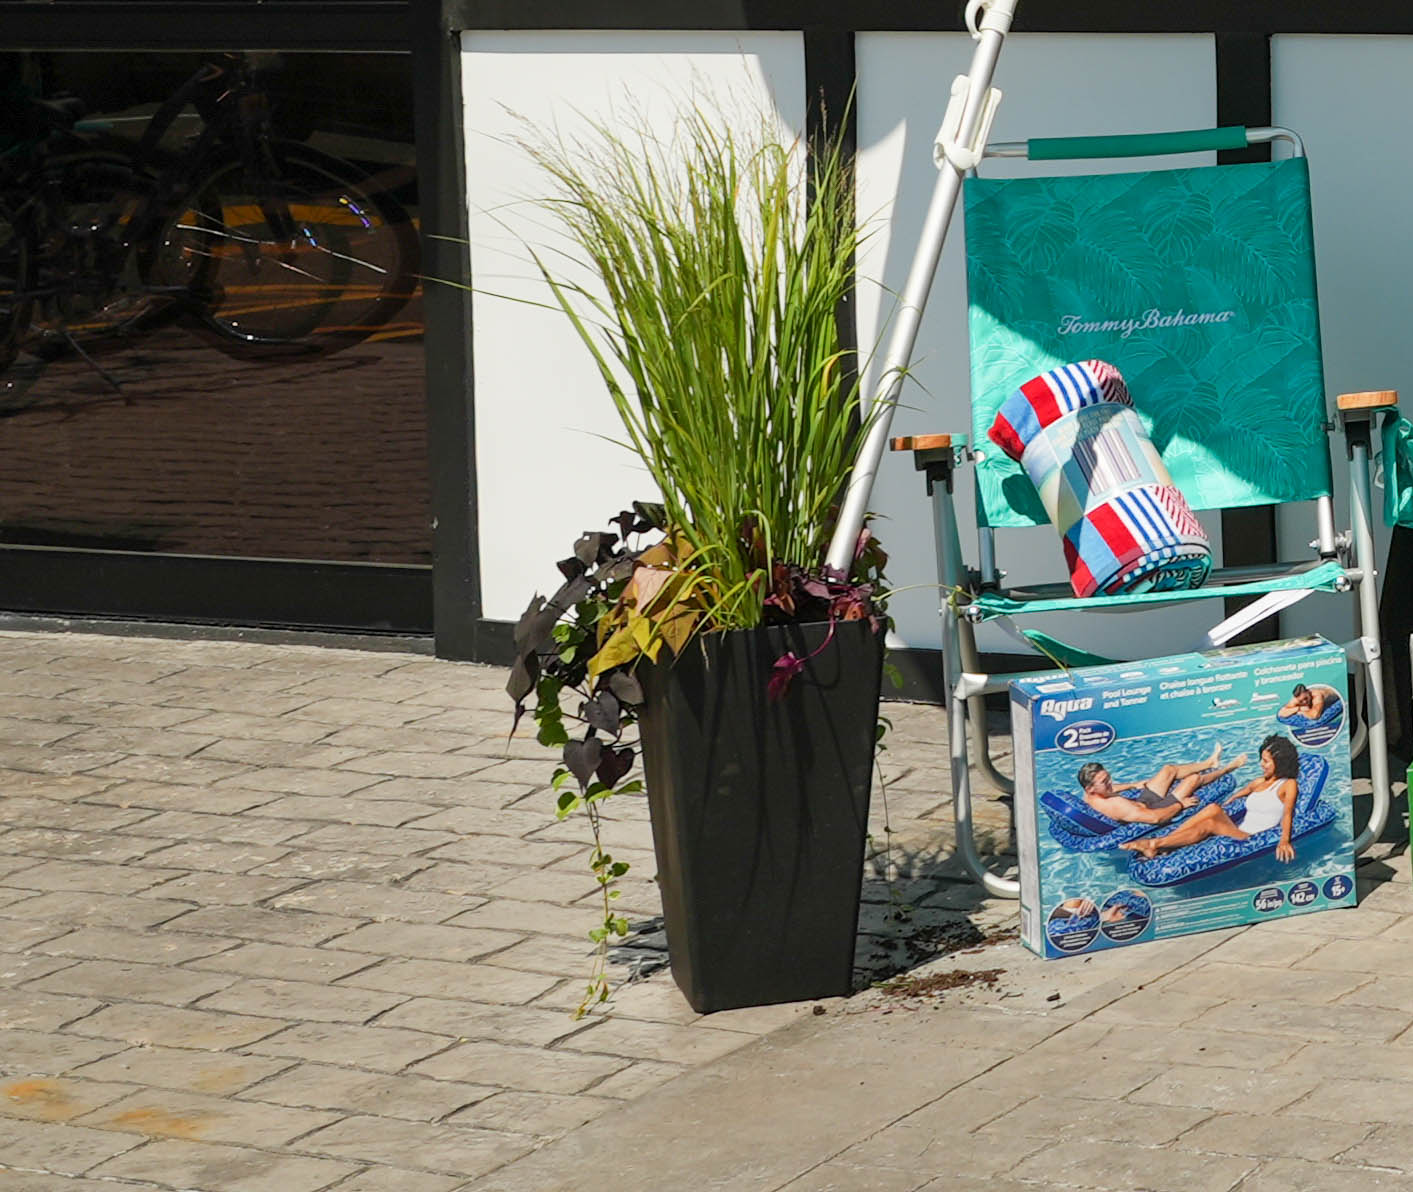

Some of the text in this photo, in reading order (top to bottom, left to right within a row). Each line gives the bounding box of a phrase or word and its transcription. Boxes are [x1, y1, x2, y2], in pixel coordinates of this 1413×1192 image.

[1057, 308, 1231, 339] Tommy Bahama
[1103, 686, 1152, 699] Pool Lounge
[1040, 697, 1095, 722] Aqua
[1103, 699, 1120, 709] and
[1063, 728, 1079, 749] 2
[1290, 892, 1306, 904] 142
